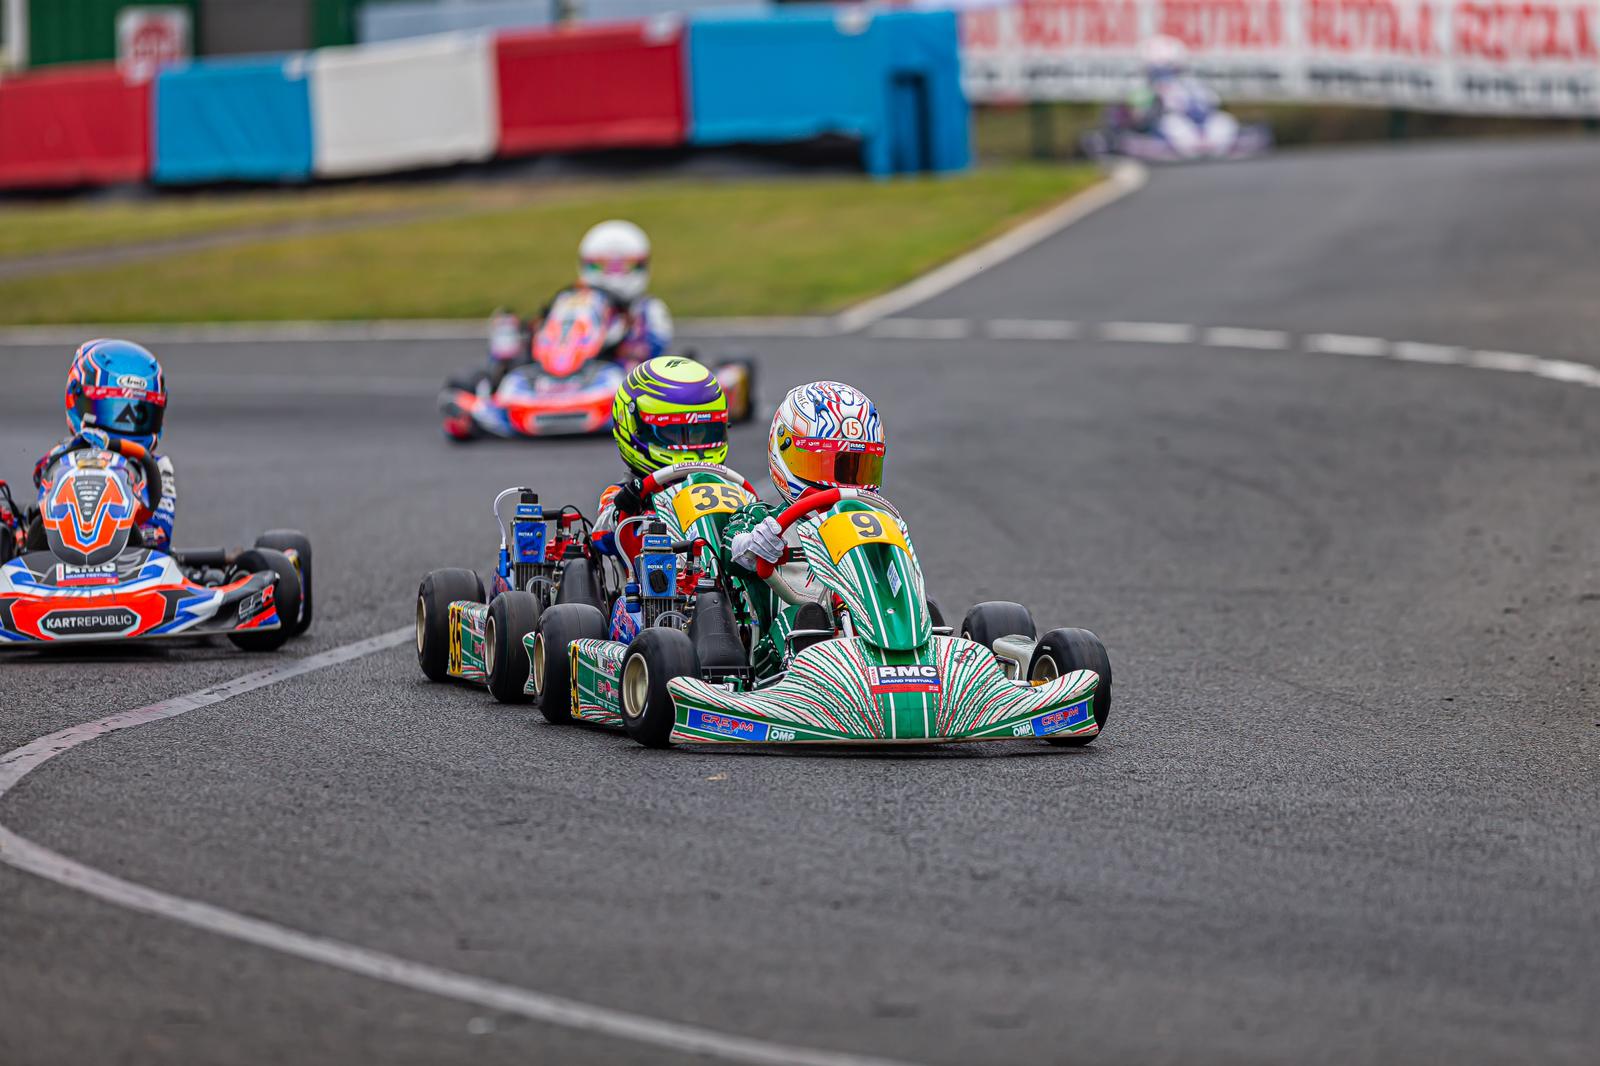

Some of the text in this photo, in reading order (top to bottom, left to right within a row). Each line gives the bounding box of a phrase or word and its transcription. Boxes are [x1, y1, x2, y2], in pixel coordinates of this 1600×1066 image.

[845, 421, 860, 436] 15
[690, 485, 745, 511] 35
[851, 512, 883, 538] 9
[46, 614, 132, 629] KARTREPUBLIC
[450, 607, 462, 673] 35
[879, 666, 937, 678] RMC
[770, 730, 796, 742] OMP
[1012, 723, 1031, 737] OMP
